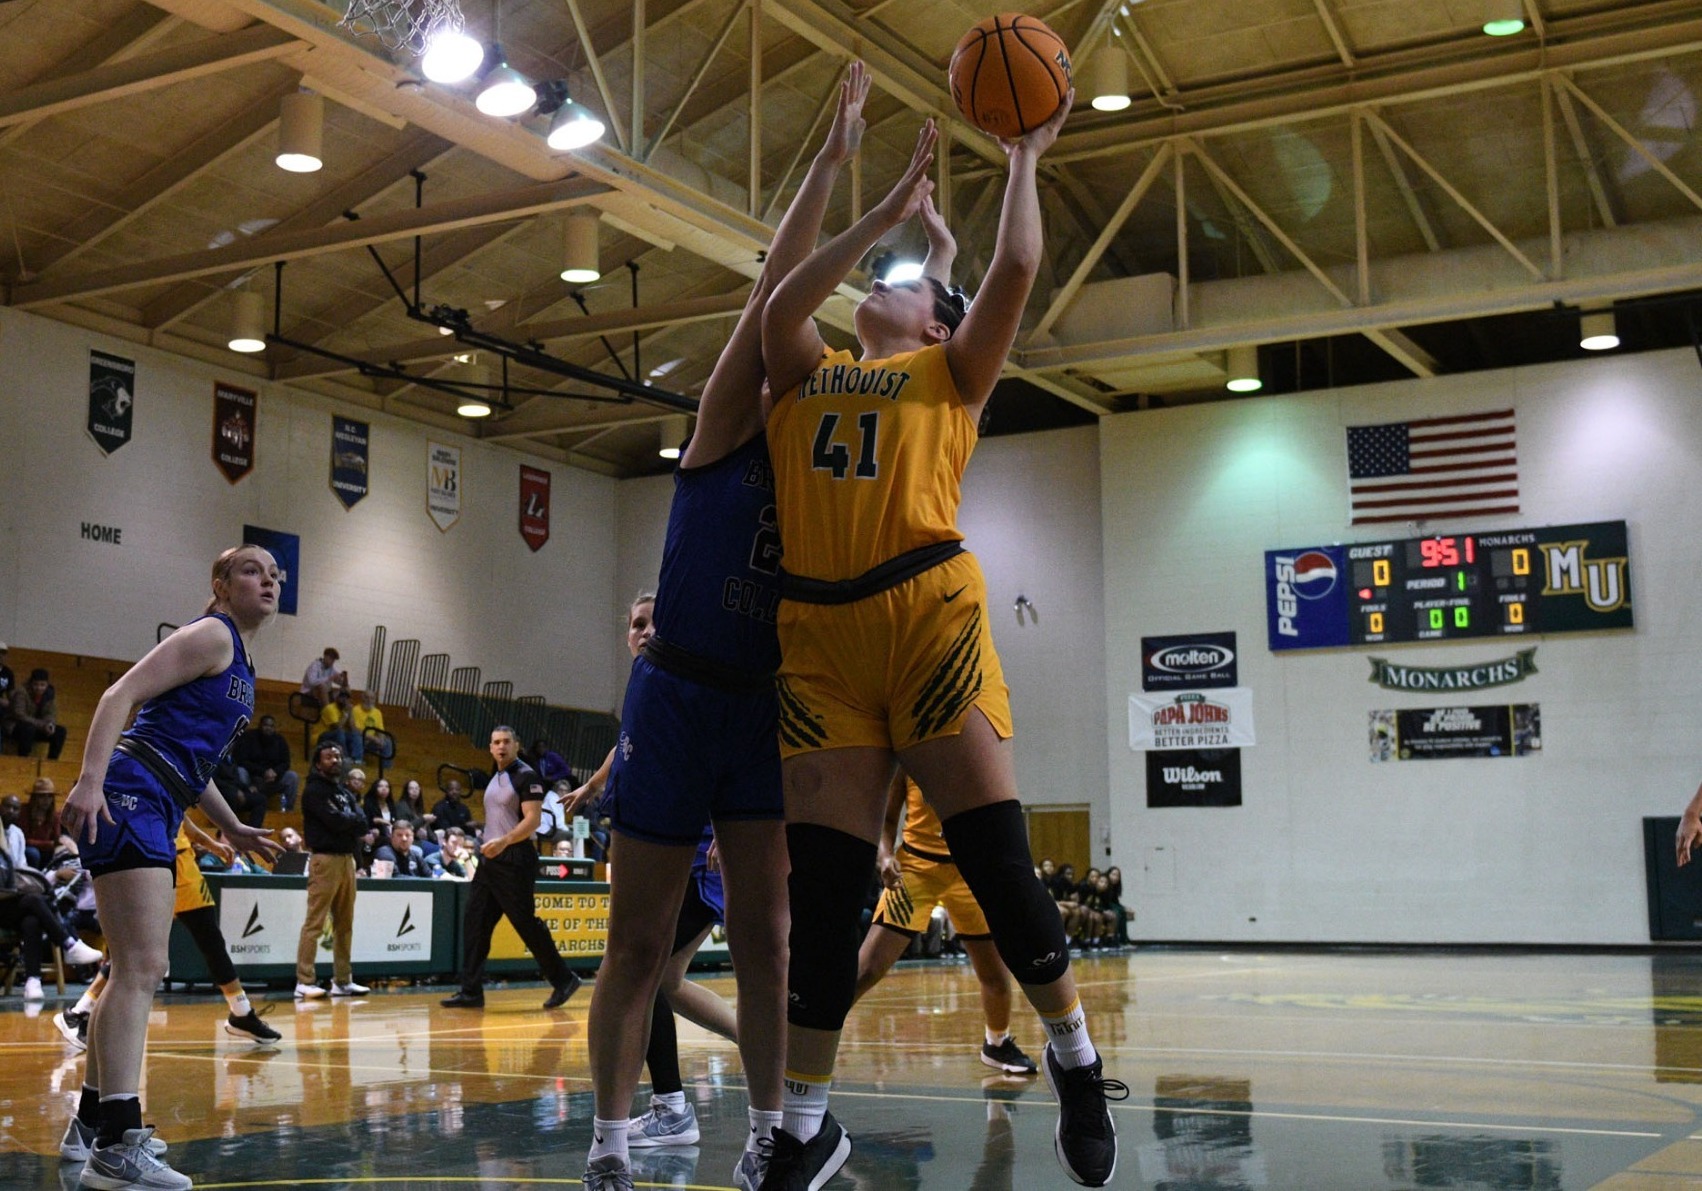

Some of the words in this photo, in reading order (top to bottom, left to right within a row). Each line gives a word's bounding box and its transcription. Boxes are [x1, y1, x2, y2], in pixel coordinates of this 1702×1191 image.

[217, 389, 253, 407] MARYVILLE
[93, 423, 125, 438] COLLEGE
[812, 410, 880, 480] 41
[220, 453, 248, 467] COLLEGE
[81, 522, 122, 545] HOME
[750, 503, 783, 576] 2
[1479, 533, 1536, 547] MONARCHS
[1349, 544, 1393, 560] GUEST
[1511, 548, 1531, 576] 0
[1373, 559, 1390, 587] 0
[1457, 571, 1466, 592] 1
[1538, 539, 1628, 613] MU
[1406, 577, 1446, 590] PERIOD
[1275, 556, 1299, 637] PEPSI
[1369, 611, 1384, 634] 0
[1508, 602, 1524, 625] 0
[1165, 650, 1219, 666] molten
[1386, 660, 1519, 689] MONARCHS
[1153, 703, 1186, 725] PAPA
[1187, 703, 1229, 724] JOHNS
[1154, 737, 1194, 747] BETTER
[1163, 766, 1224, 783] Wilson
[578, 896, 597, 909] TO
[563, 917, 581, 930] OF
[556, 938, 606, 952] ARCHS
